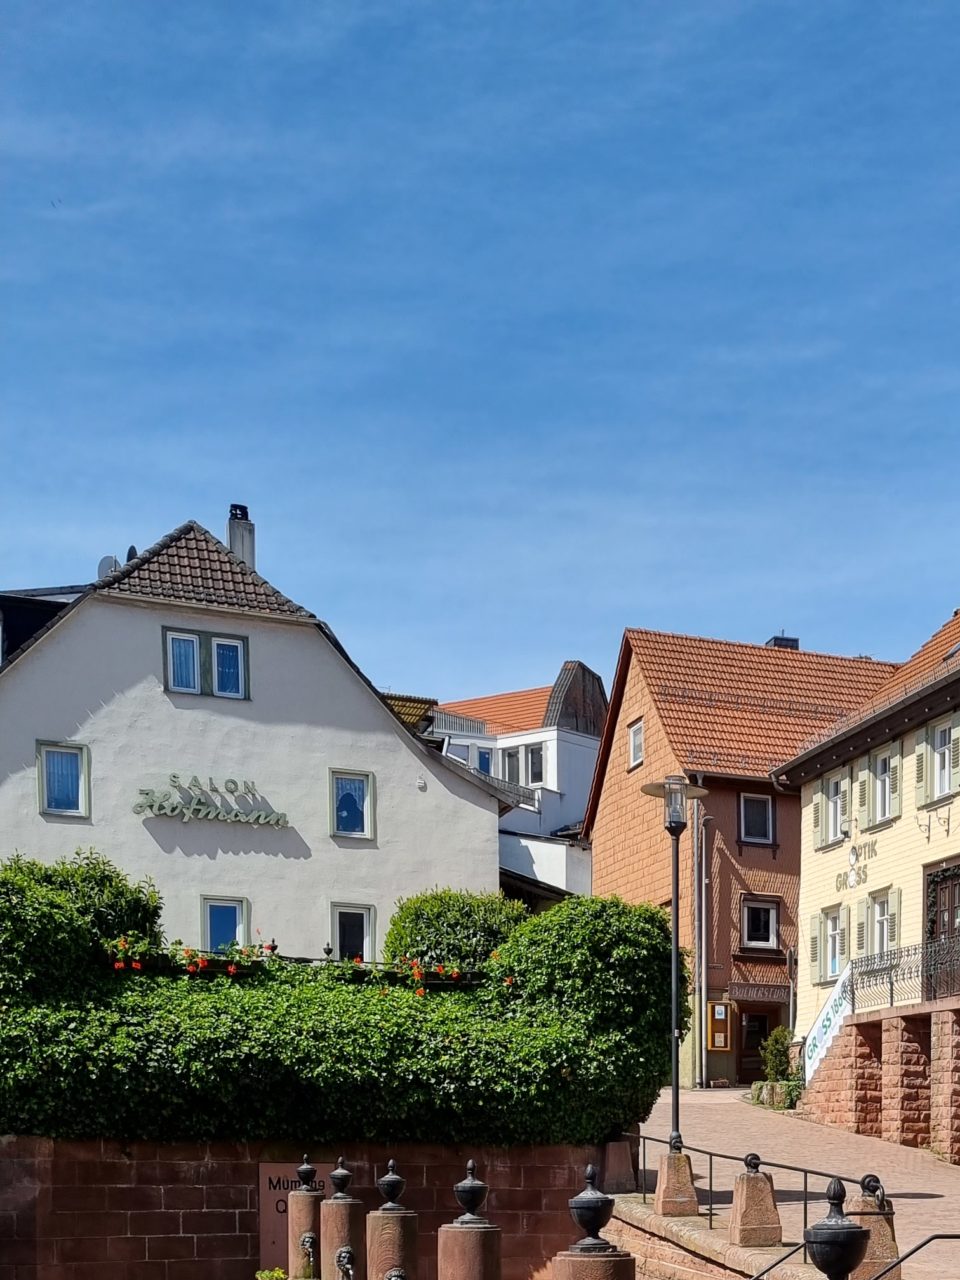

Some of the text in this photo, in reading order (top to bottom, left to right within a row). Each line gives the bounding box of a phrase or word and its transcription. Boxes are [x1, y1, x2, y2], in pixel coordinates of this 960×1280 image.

[169, 772, 256, 796] SALON
[132, 788, 289, 827] Hofmann
[268, 1175, 326, 1191] Mümng
